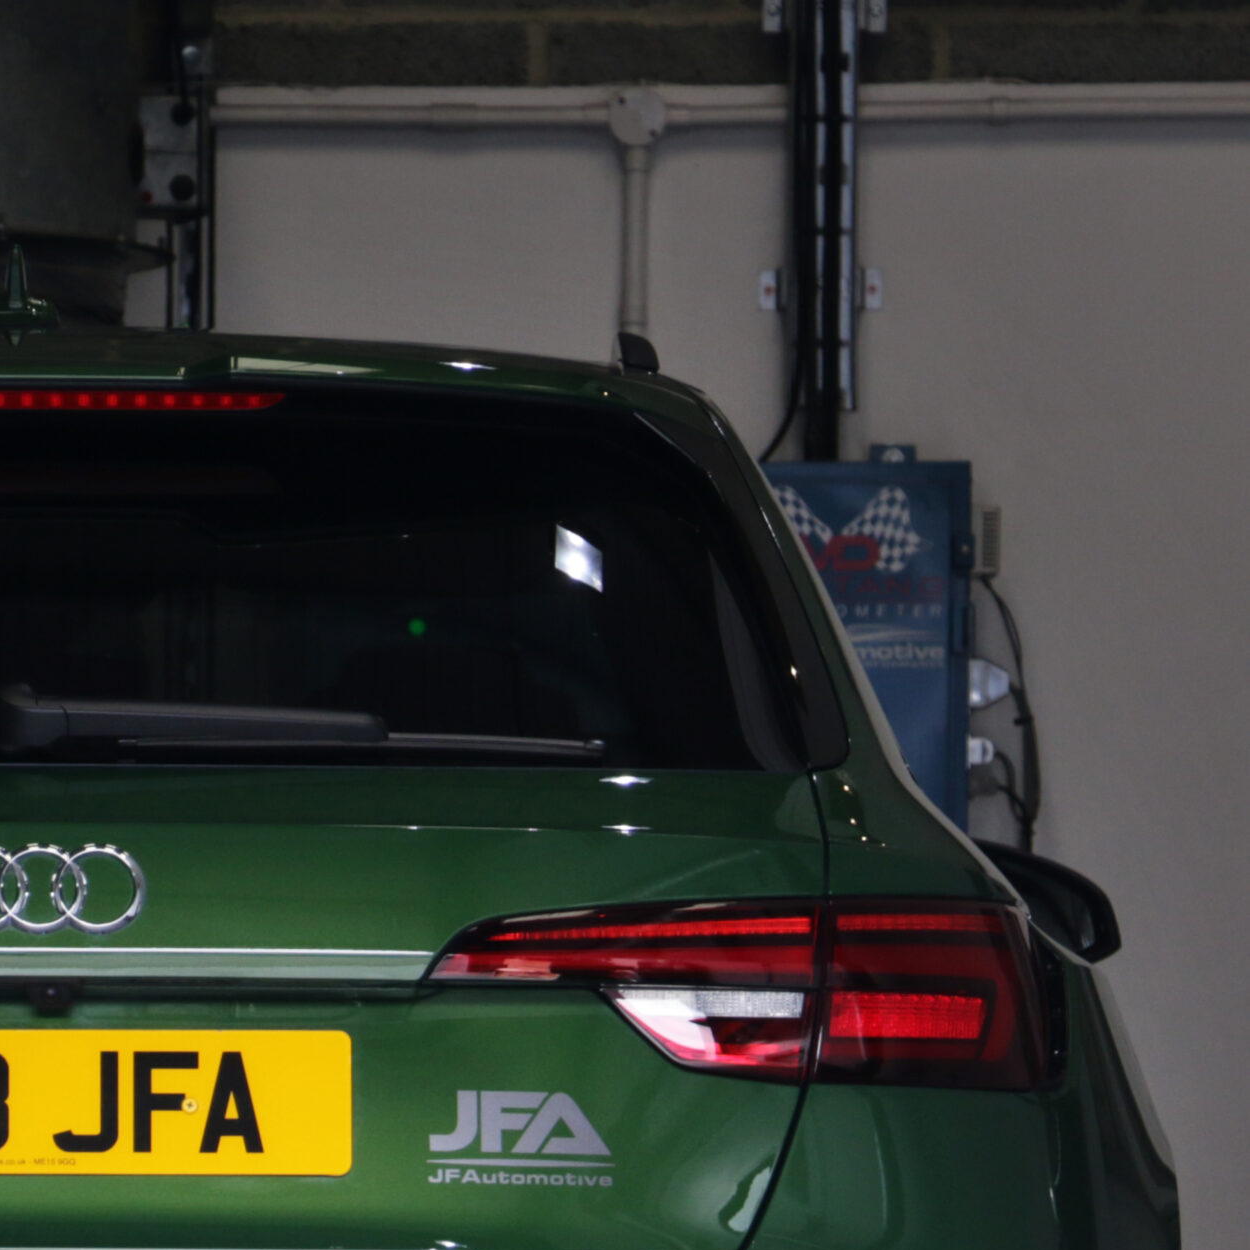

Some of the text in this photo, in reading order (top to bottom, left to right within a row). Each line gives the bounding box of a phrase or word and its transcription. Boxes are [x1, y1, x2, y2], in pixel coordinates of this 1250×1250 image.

[53, 1050, 265, 1154] JFA
[428, 1089, 612, 1156] JFA
[427, 1168, 614, 1187] JFAutomotive
